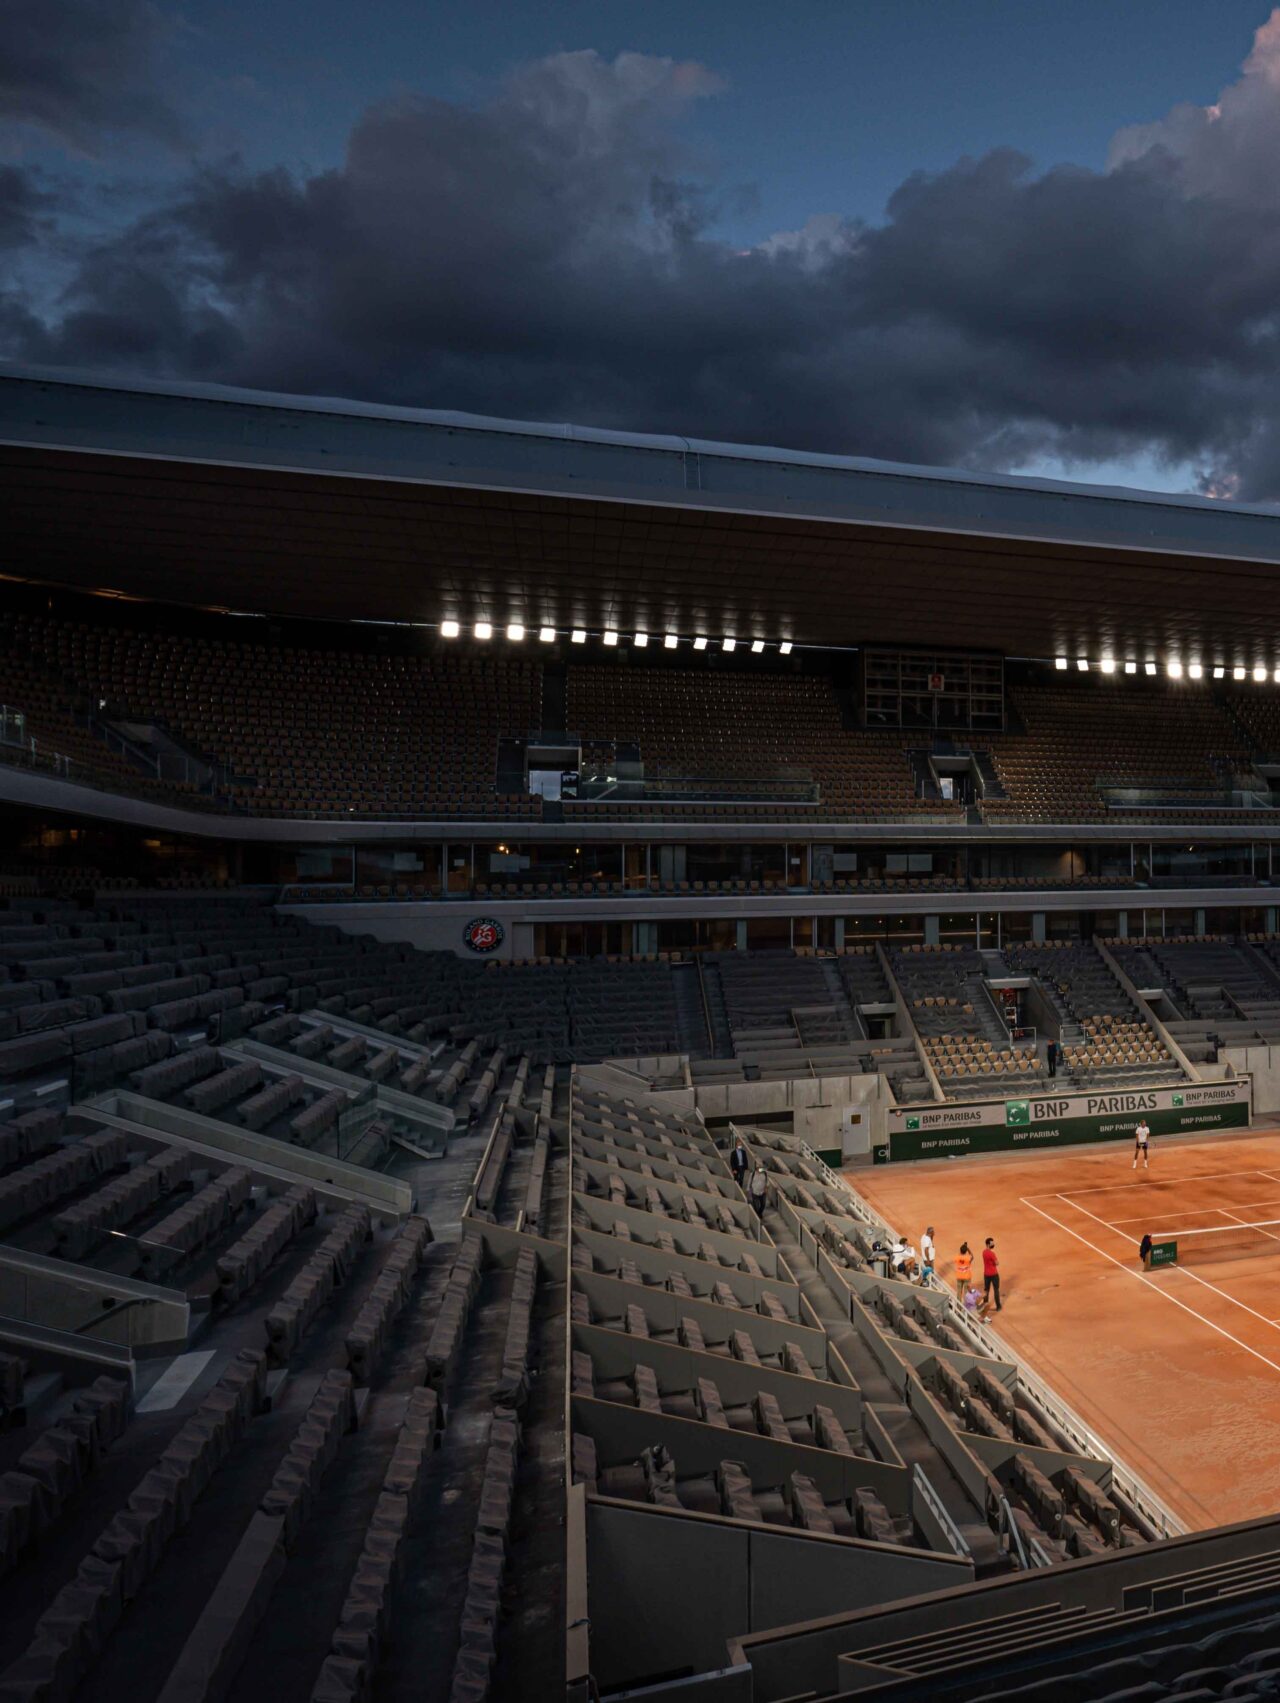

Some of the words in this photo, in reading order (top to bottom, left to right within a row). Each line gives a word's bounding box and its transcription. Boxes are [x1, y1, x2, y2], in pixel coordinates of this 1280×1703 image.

[1185, 1093, 1202, 1101] BNP
[1203, 1090, 1236, 1099] PARIBAS
[1034, 1101, 1069, 1119] BNP
[1087, 1094, 1157, 1115] PARIBAS
[922, 1115, 942, 1124] BNP
[943, 1111, 982, 1122] PARIBAS
[1180, 1117, 1195, 1125] BNP
[1195, 1114, 1222, 1123] PARIBAS
[1013, 1132, 1029, 1141] BNP
[1029, 1129, 1060, 1139] PARIBAS
[1099, 1125, 1115, 1133] BNP
[921, 1140, 938, 1149] BNP
[938, 1137, 970, 1147] PARIBAS
